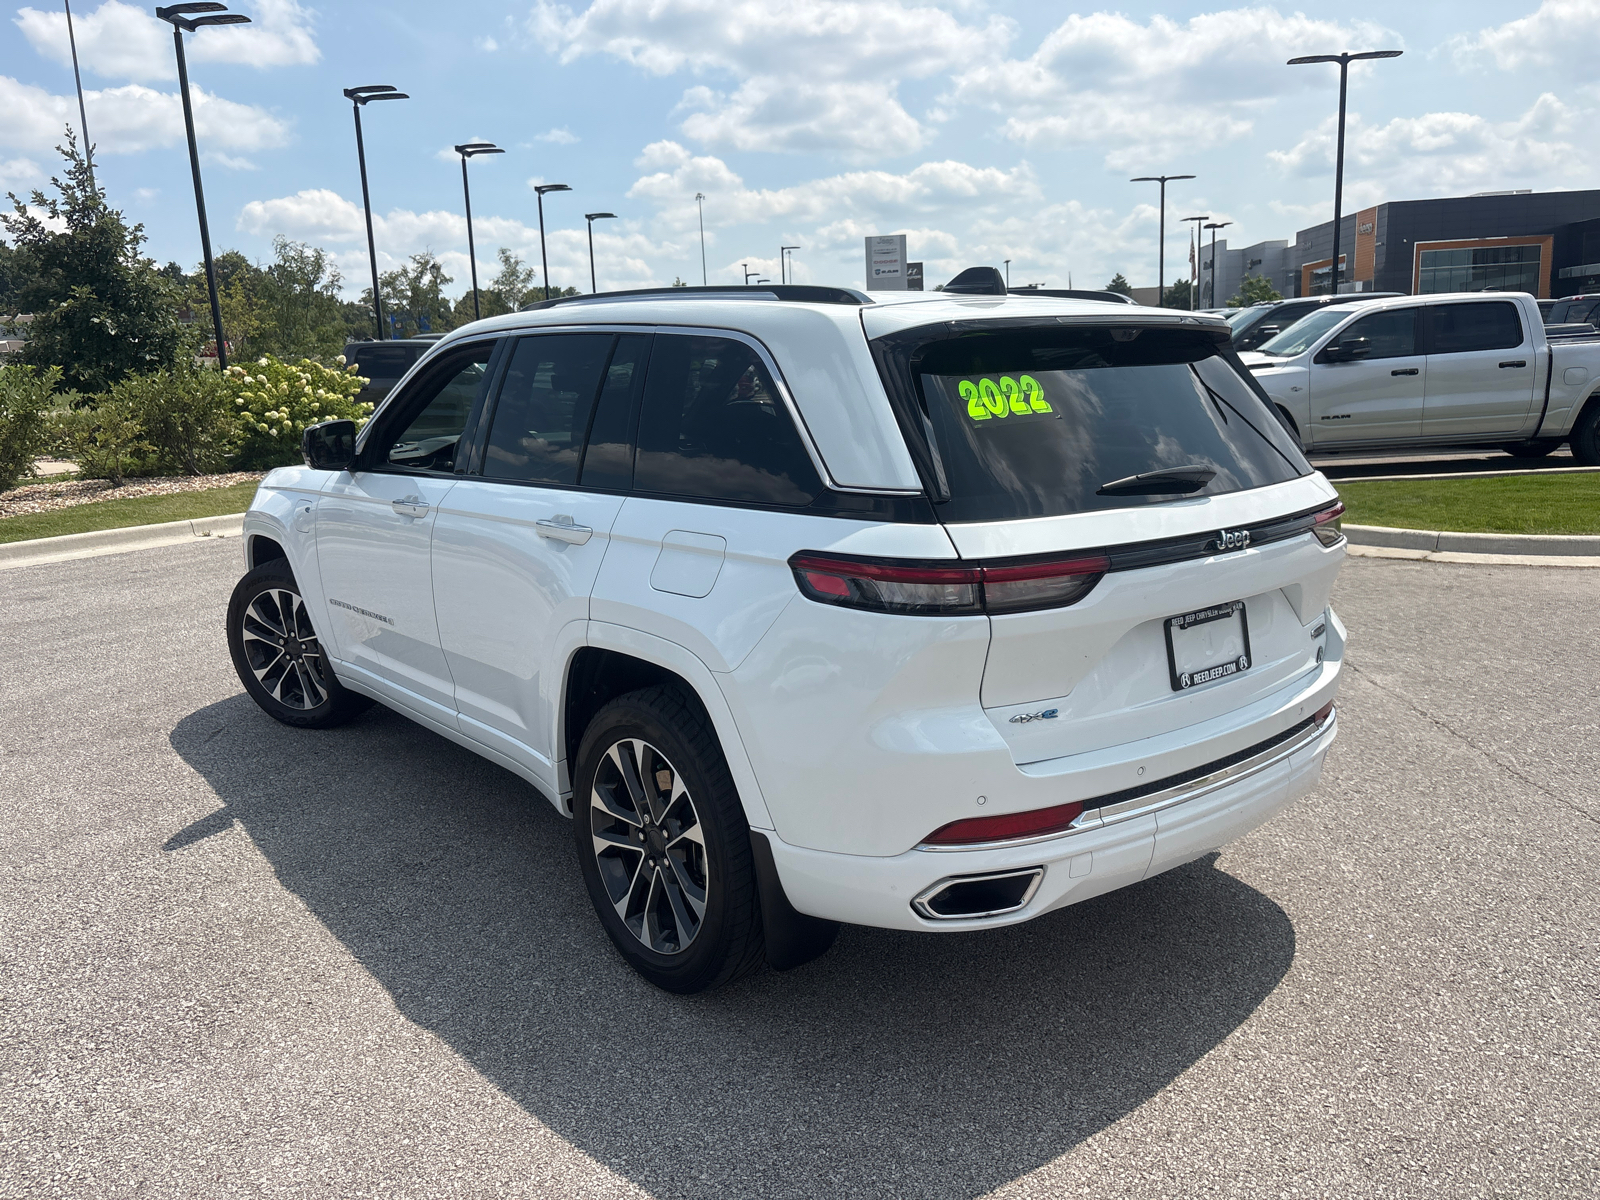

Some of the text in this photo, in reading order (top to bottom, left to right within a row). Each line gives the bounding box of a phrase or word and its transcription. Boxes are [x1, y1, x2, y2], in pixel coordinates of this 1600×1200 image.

[958, 374, 1053, 421] 2022
[1216, 529, 1251, 550] Jeep
[1171, 616, 1184, 627] REED
[1184, 613, 1196, 624] JEEP
[1196, 609, 1219, 621] CHRYSLER
[1193, 662, 1237, 685] REEDJEEP.COM
